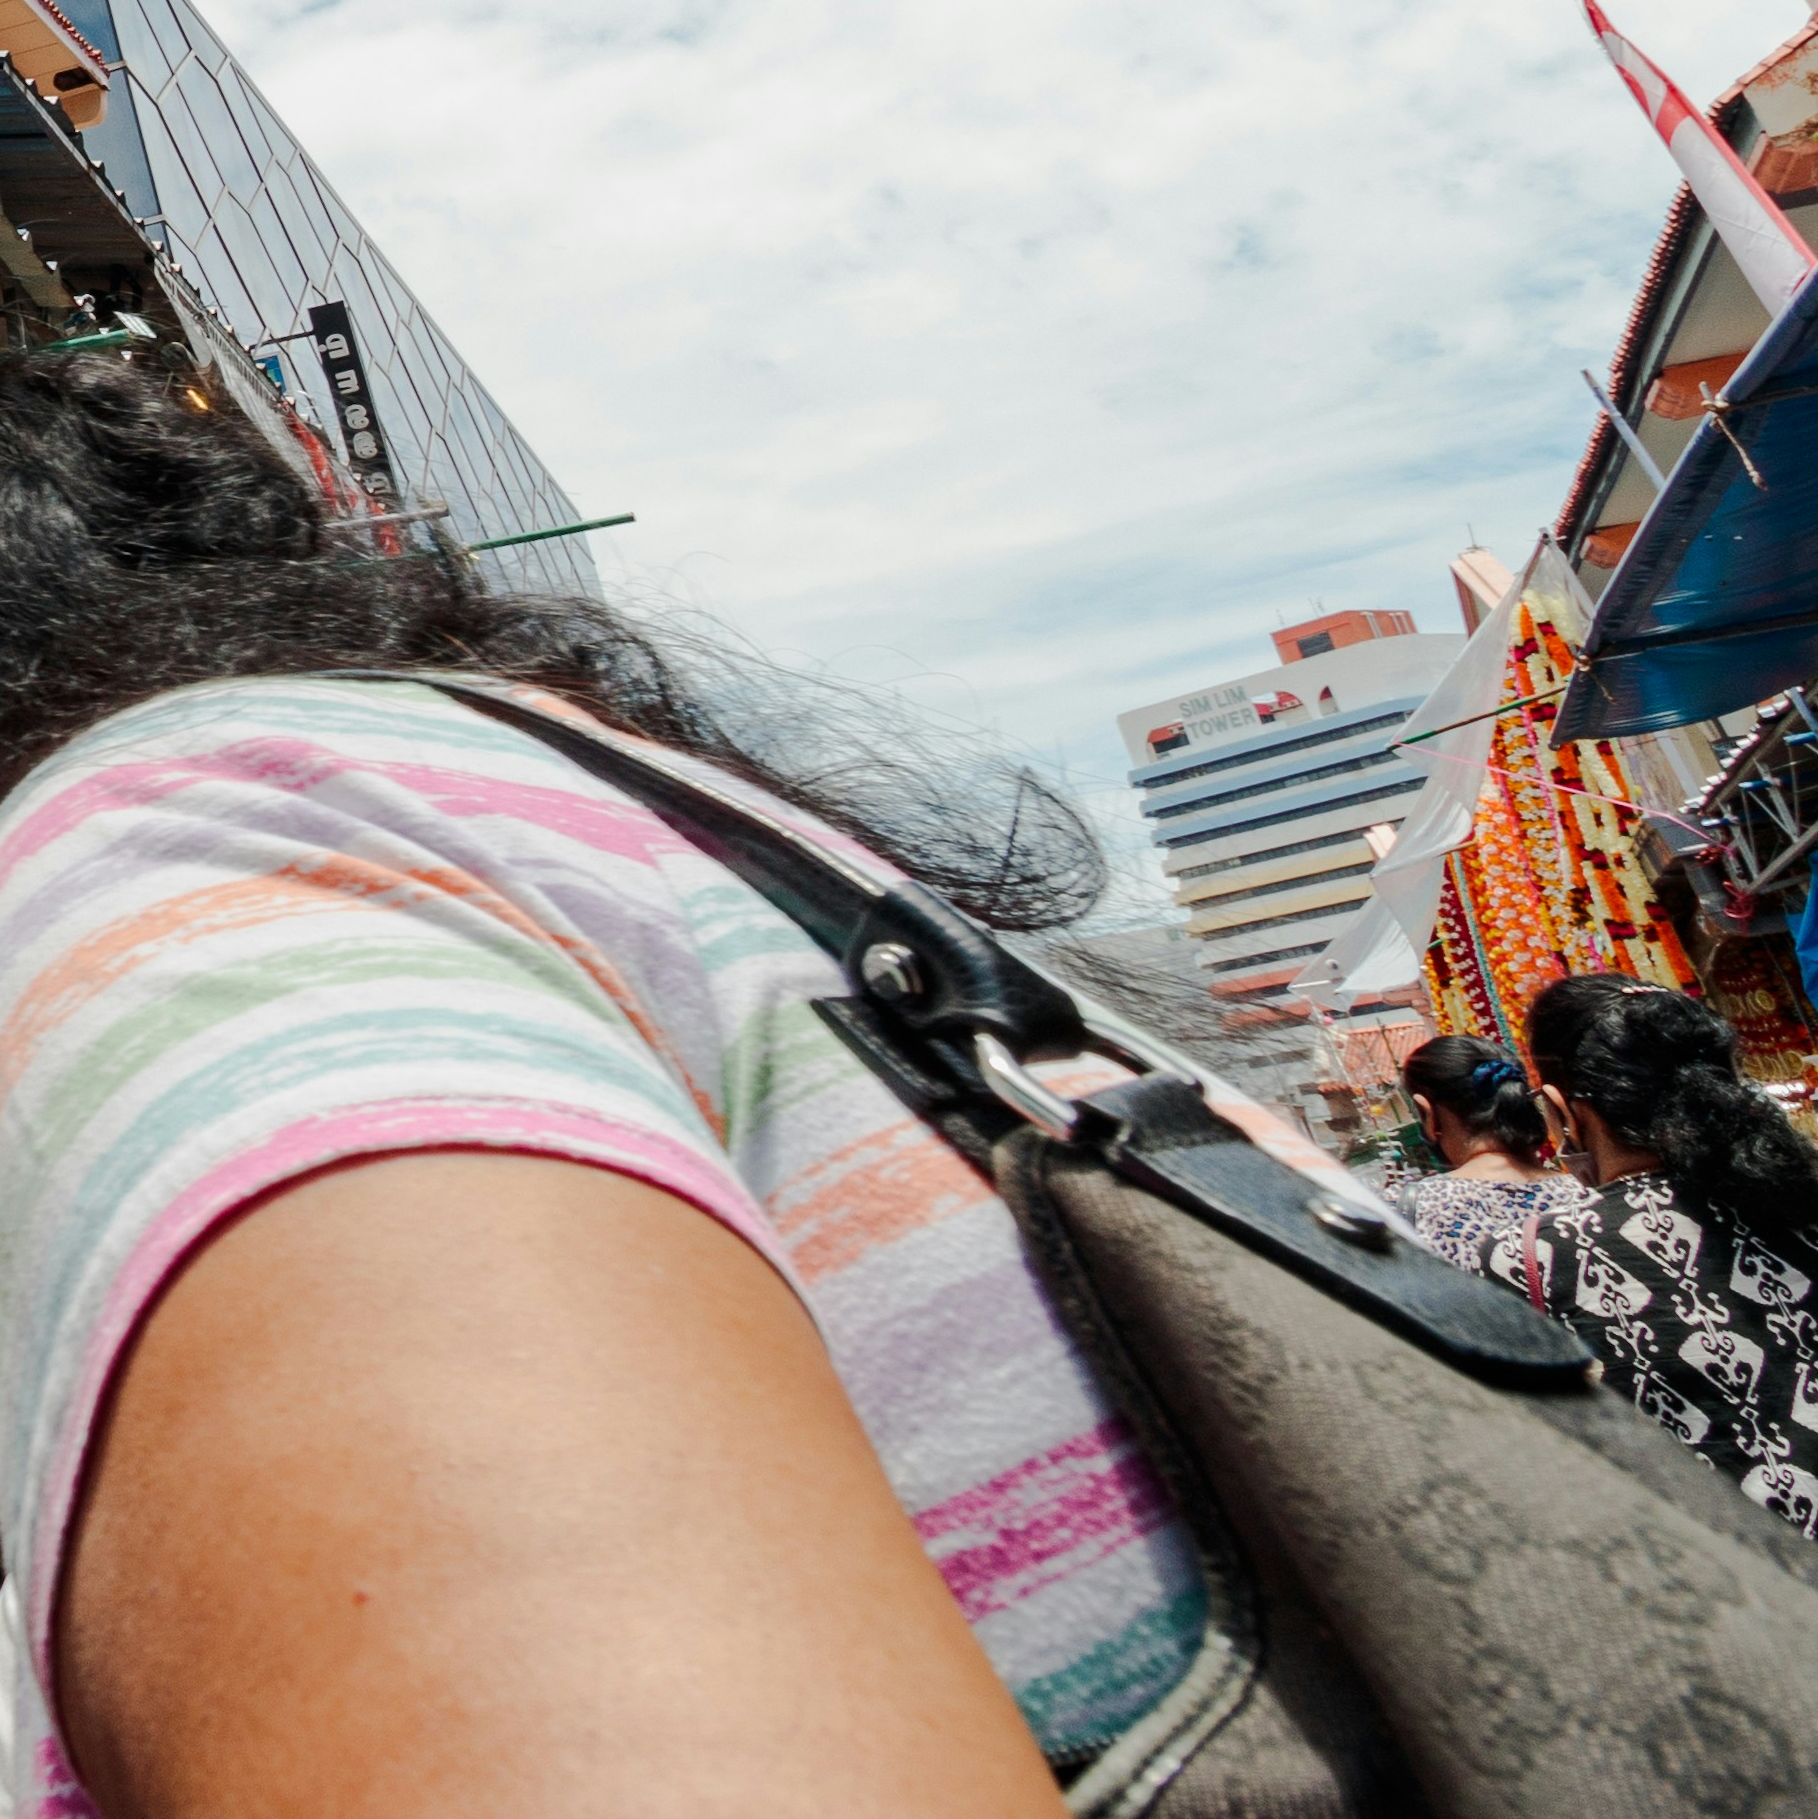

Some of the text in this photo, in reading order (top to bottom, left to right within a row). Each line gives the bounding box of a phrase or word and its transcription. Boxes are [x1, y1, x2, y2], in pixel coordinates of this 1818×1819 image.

[1180, 685, 1247, 718] SIM LIM
[1187, 708, 1256, 738] TOWER
